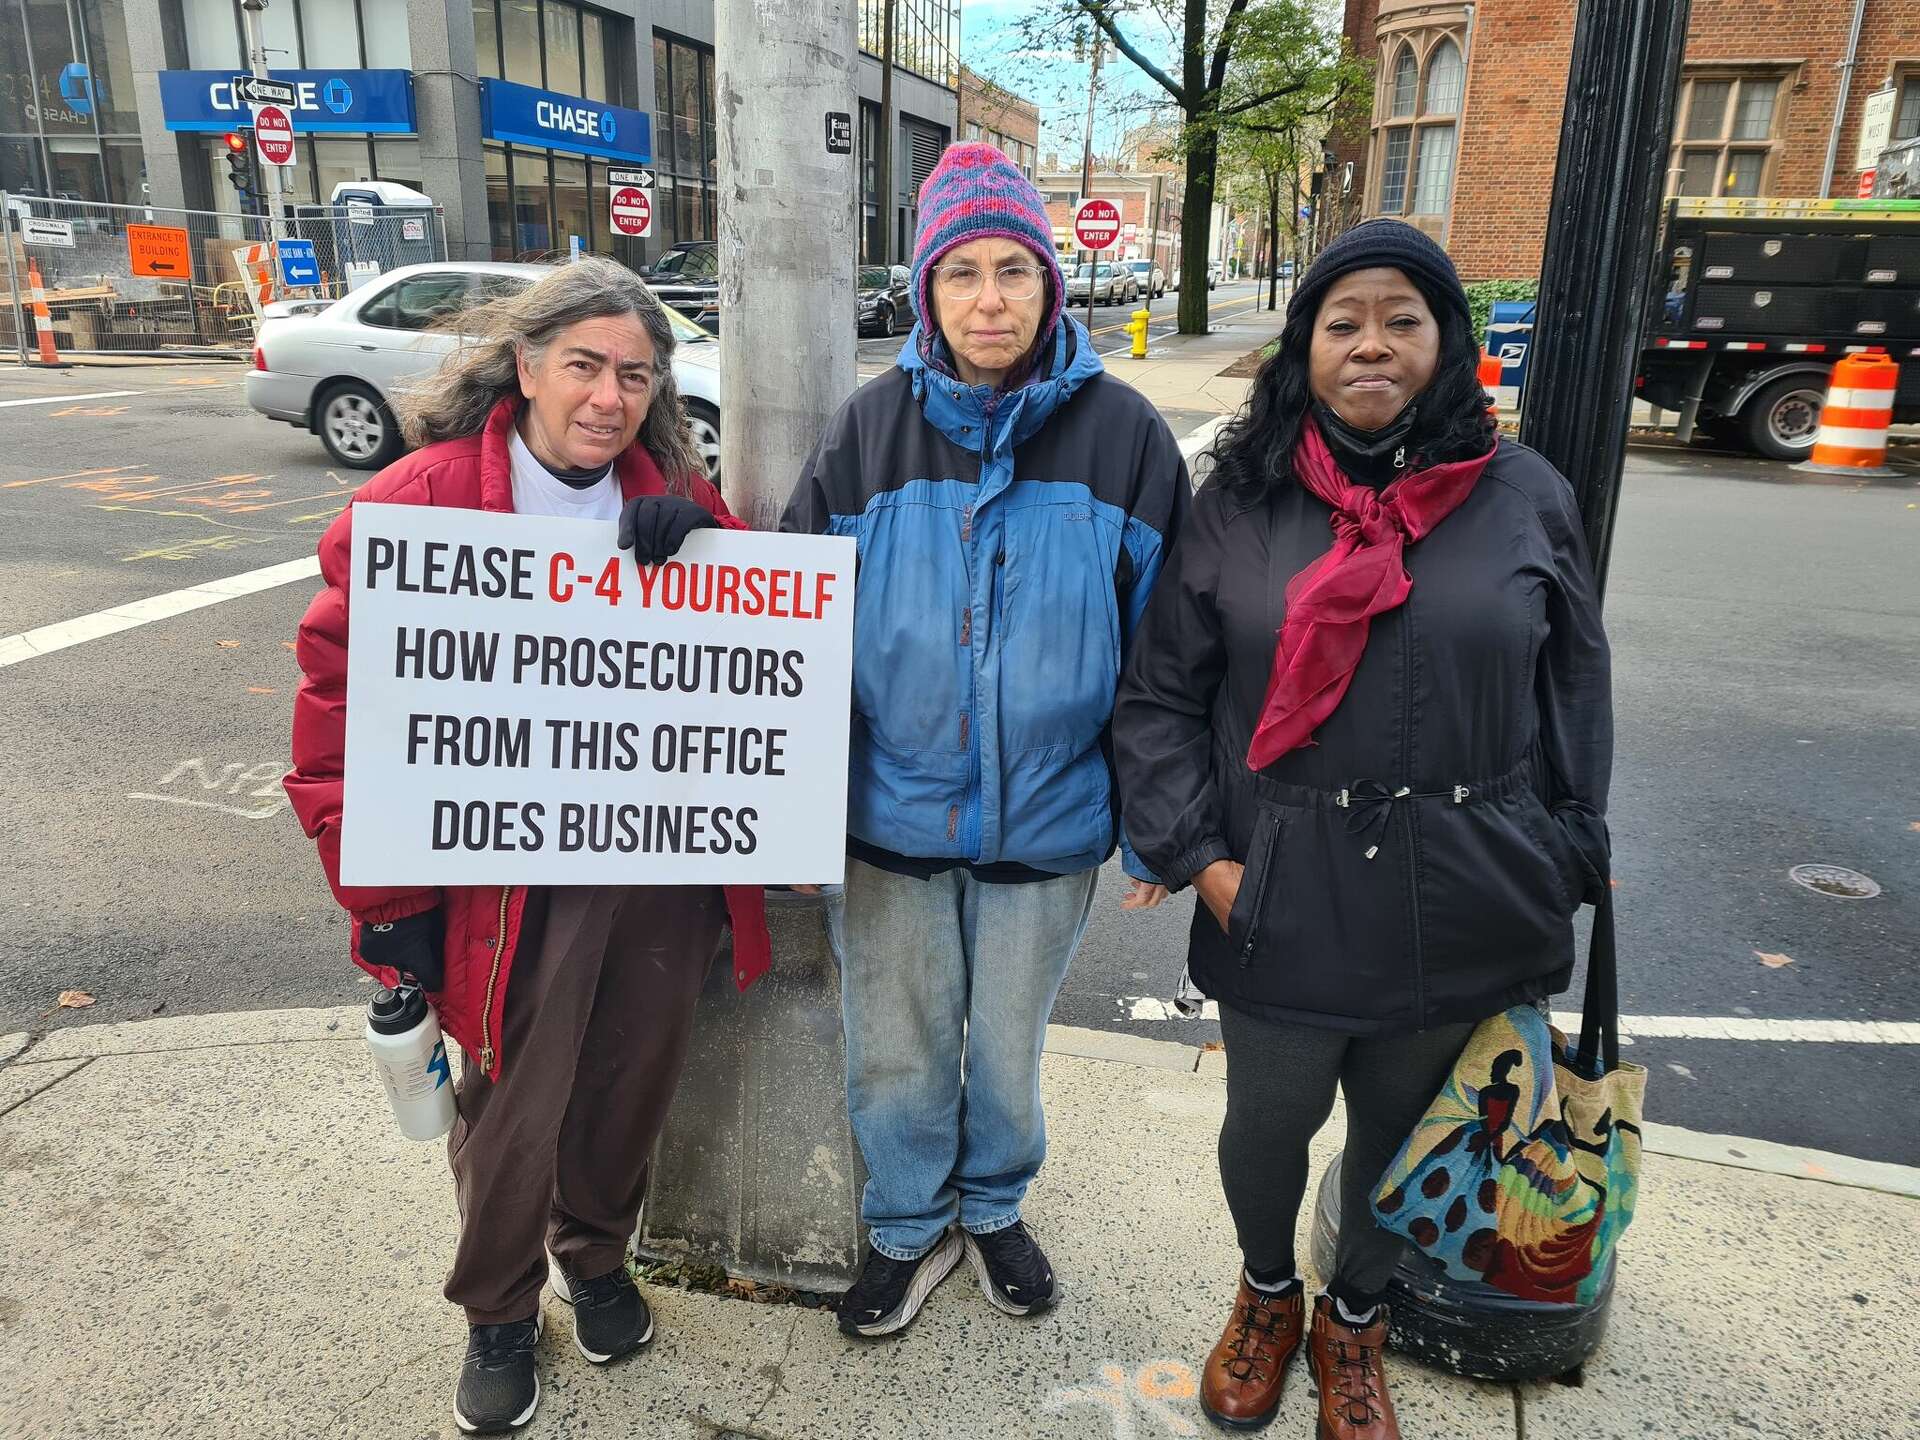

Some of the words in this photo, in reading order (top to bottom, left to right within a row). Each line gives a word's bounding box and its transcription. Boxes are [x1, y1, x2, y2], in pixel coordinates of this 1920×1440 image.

[251, 84, 267, 95] ONE
[271, 87, 285, 97] WAY
[260, 117, 269, 126] DO
[273, 118, 286, 127] NOT
[537, 101, 599, 137] CHASE
[266, 143, 287, 153] ENTER
[615, 173, 629, 181] ONE
[616, 196, 626, 204] DO
[631, 197, 645, 206] NOT
[1082, 209, 1094, 218] DO
[1098, 209, 1114, 218] NOT
[619, 217, 642, 226] ENTER
[131, 231, 172, 241] ENTRANCE
[175, 234, 184, 243] TO
[1083, 231, 1110, 240] ENTER
[139, 245, 180, 257] BUILDING
[366, 537, 536, 600] PLEASE
[548, 552, 622, 607] C-4
[635, 561, 837, 620] YOURSELF
[395, 626, 500, 683] HOW
[512, 634, 805, 698] PROSECUTORS
[407, 713, 531, 768] FROM
[545, 719, 640, 772] THIS
[651, 723, 788, 776] OFFICE
[432, 800, 545, 852] DOES
[558, 803, 759, 855] BUSINESS
